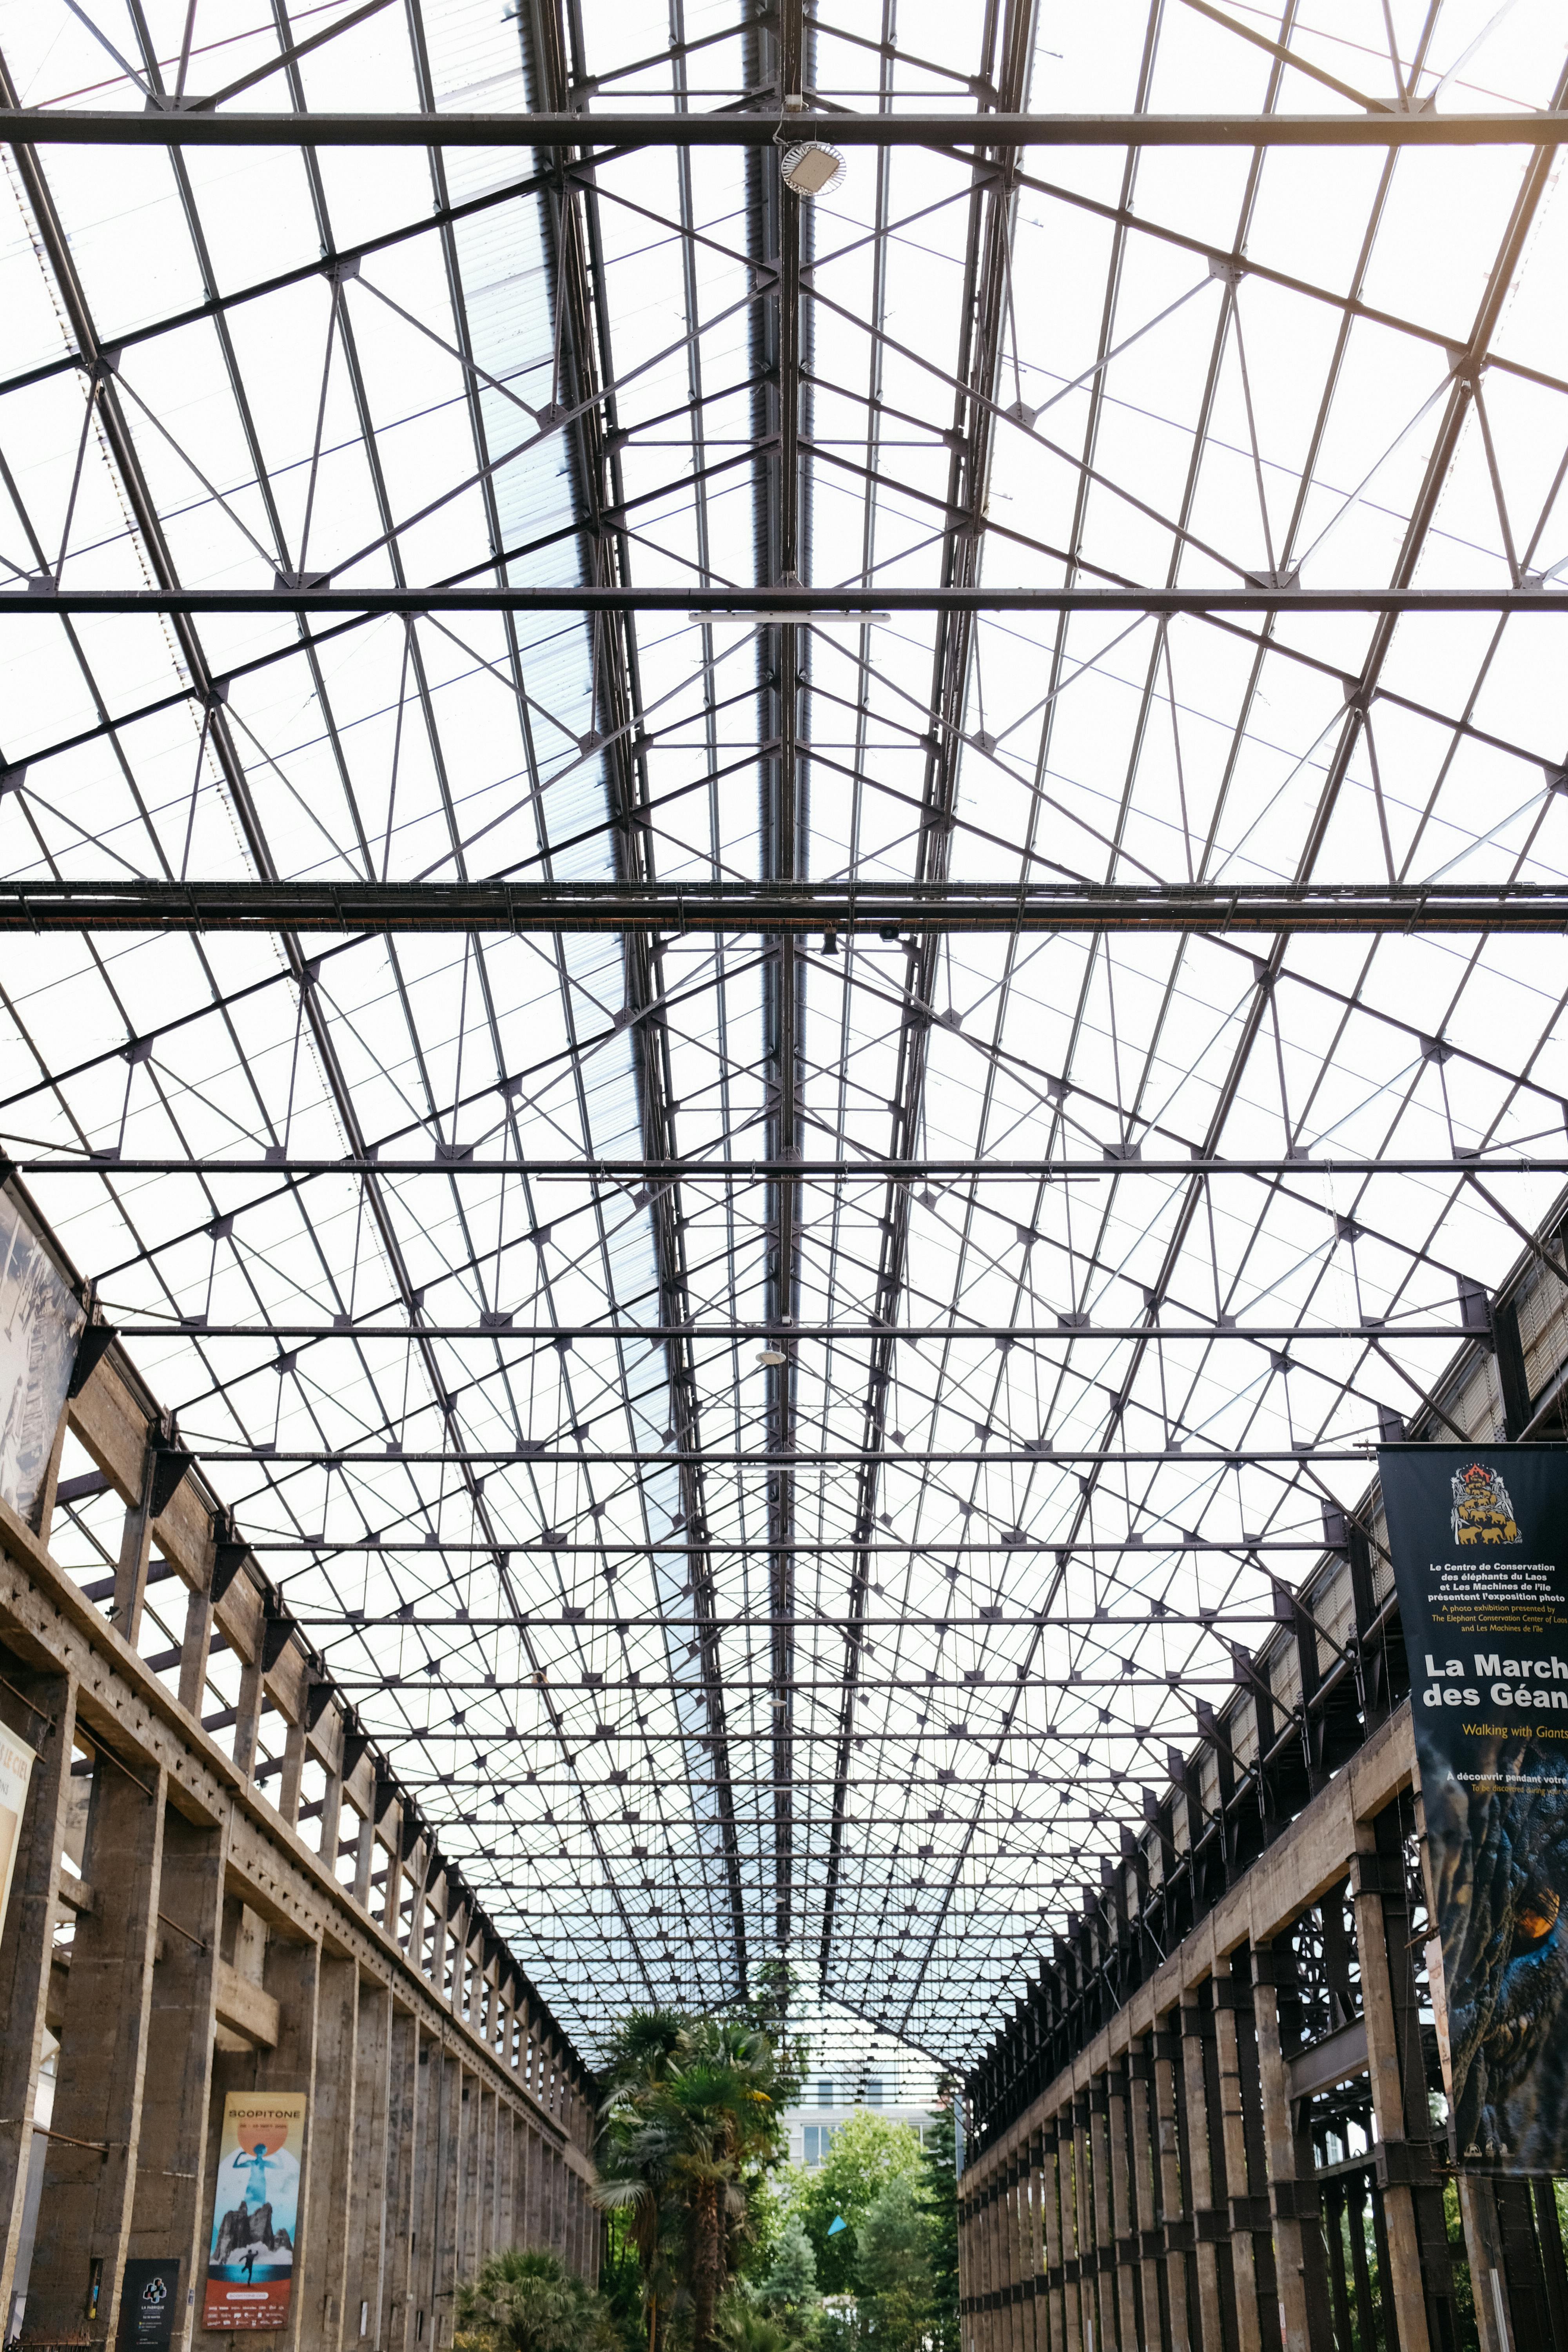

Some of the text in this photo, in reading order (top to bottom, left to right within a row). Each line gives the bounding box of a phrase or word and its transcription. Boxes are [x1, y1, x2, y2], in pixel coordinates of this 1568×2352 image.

[1461, 1573, 1508, 1582] éléphants
[1428, 1593, 1565, 1602] présentent l'exposition photo
[1450, 1605, 1472, 1613] photo
[1547, 1606, 1555, 1614] by
[1447, 1615, 1476, 1623] Elephant
[1523, 1614, 1543, 1622] Center
[1545, 1615, 1552, 1624] of
[1553, 1615, 1568, 1624] Laos
[1425, 1654, 1465, 1677] La
[1423, 1683, 1481, 1707] des
[1462, 1724, 1508, 1739] Walking
[1511, 1726, 1532, 1738] with
[1457, 1772, 1503, 1781] découvrir
[1505, 1774, 1542, 1783] pendant
[1543, 1776, 1567, 1784] votre
[1472, 1784, 1480, 1792] To
[1492, 1784, 1524, 1793] discovered
[1526, 1786, 1545, 1796] during
[229, 2109, 301, 2119] SCOPITONE
